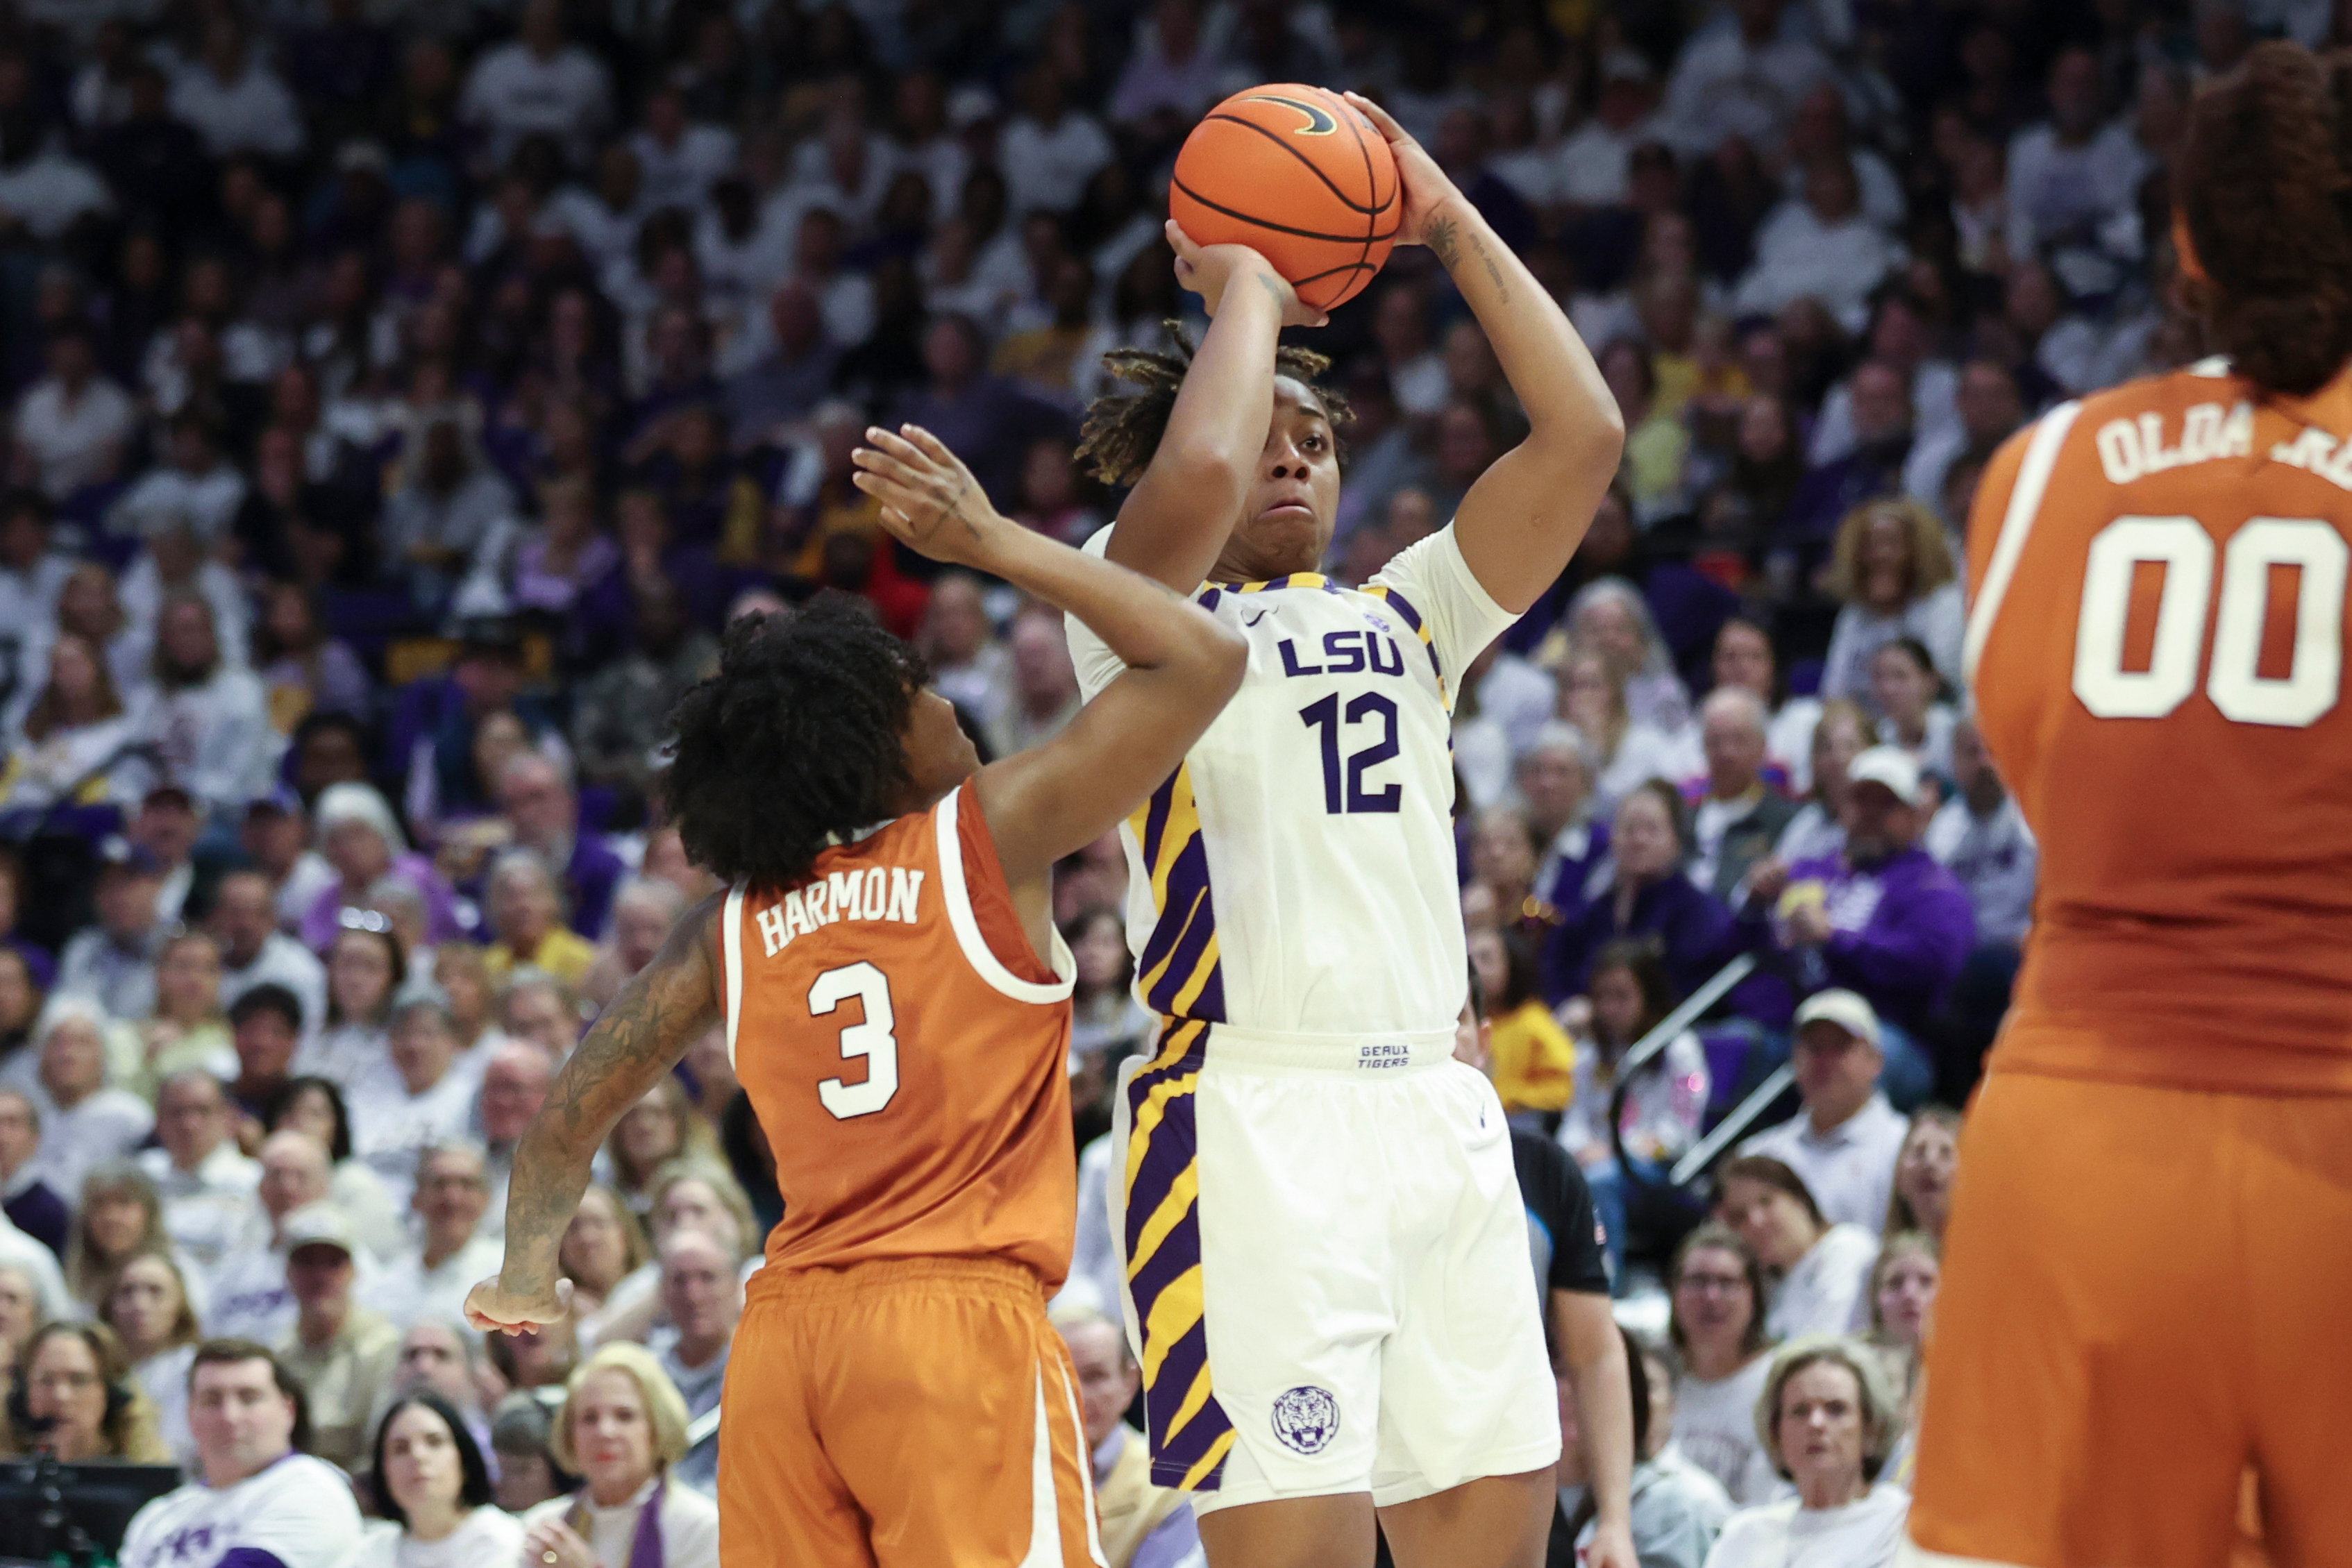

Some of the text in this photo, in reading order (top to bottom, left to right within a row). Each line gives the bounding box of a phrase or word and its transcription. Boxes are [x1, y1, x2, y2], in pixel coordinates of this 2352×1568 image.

[1277, 630, 1405, 678] LSU
[2072, 514, 2351, 727] 00
[1297, 691, 1402, 815] 12
[755, 866, 925, 959] HARMON
[807, 960, 898, 1120] 3
[1358, 1058, 1410, 1068] TIGERS
[1361, 1045, 1409, 1056] GEAUX
